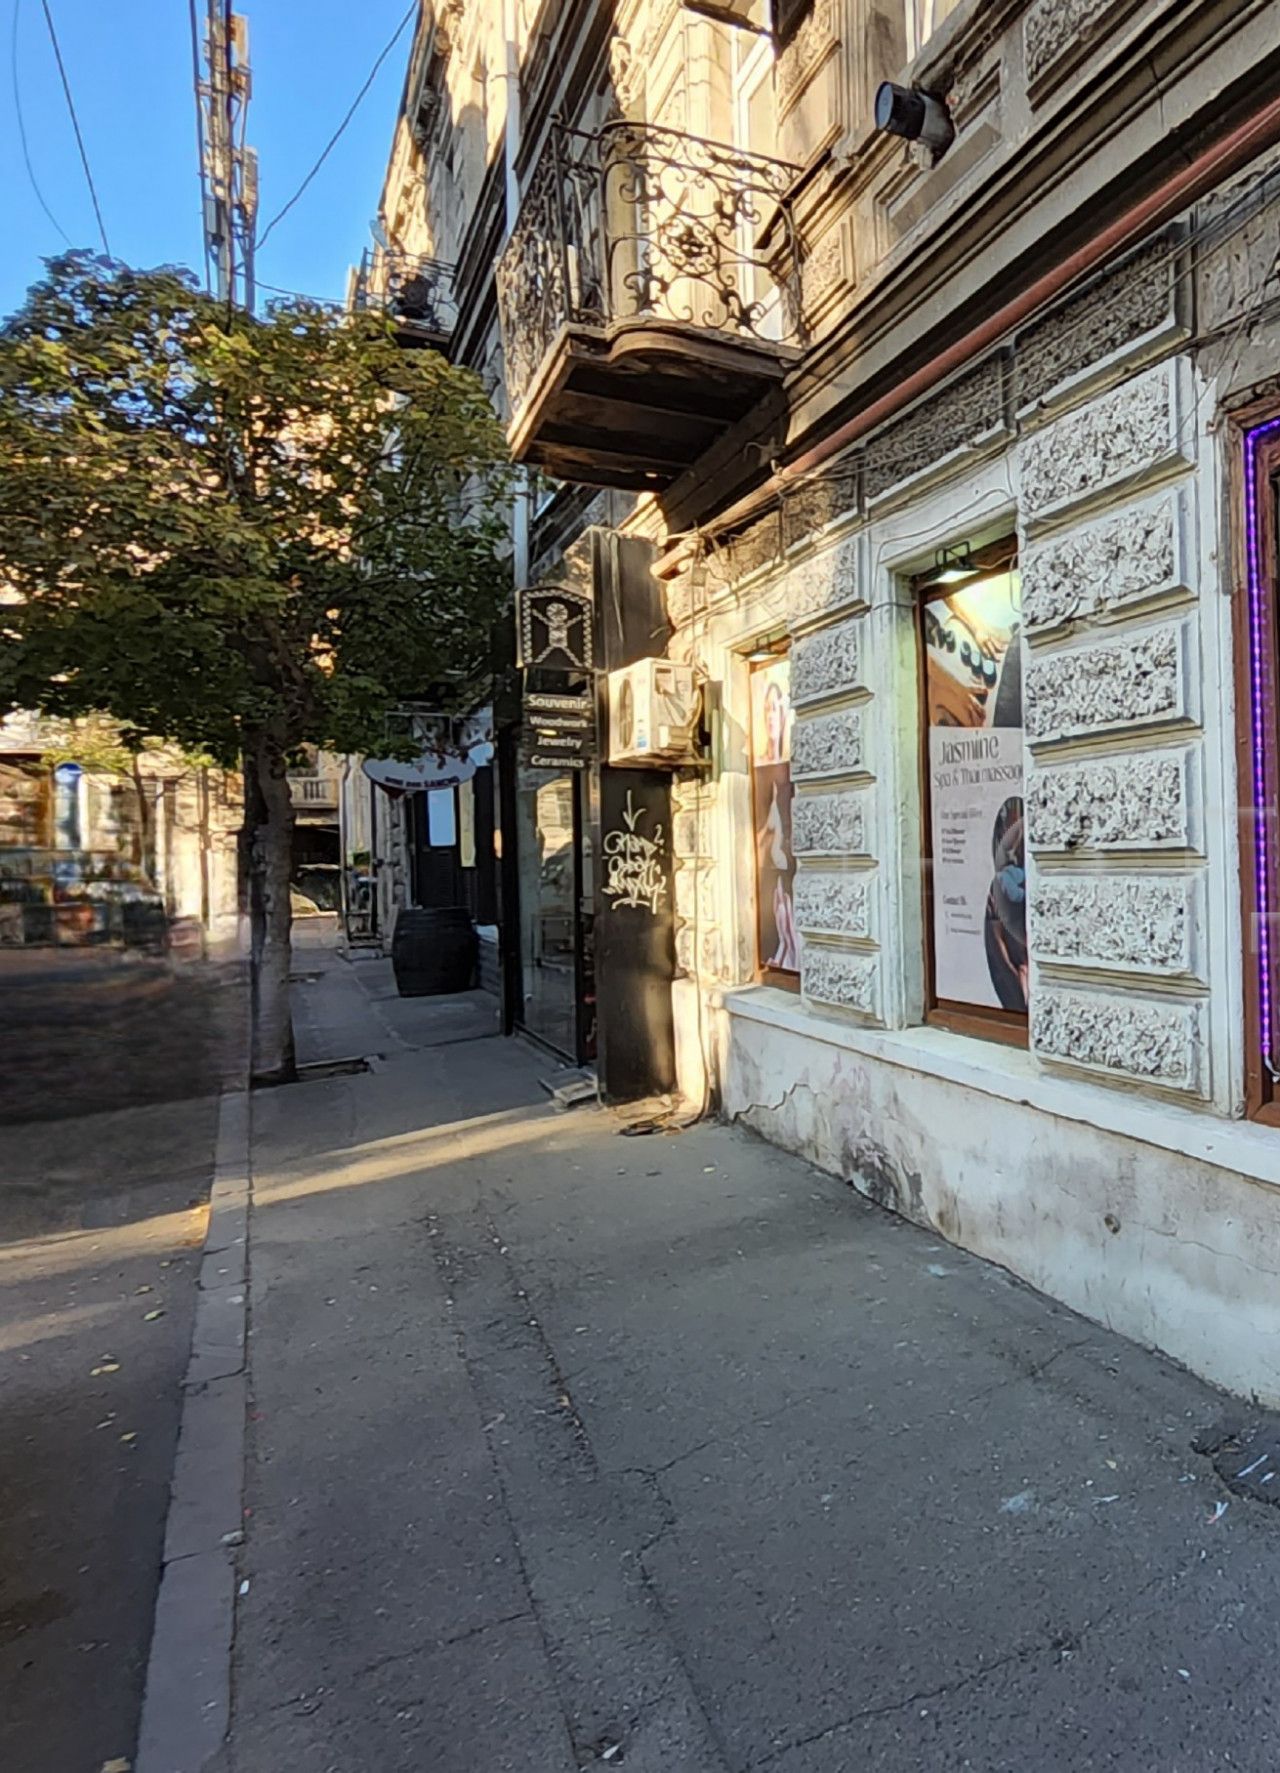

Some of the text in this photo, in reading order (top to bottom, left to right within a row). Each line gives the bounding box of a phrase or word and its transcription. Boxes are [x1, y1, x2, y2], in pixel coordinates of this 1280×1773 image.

[528, 695, 588, 709] Souvenir
[529, 716, 588, 728] Woodwork
[536, 736, 583, 750] Jewelry
[938, 731, 999, 765] Jasmine
[531, 755, 585, 768] Ceramics
[960, 764, 980, 786] Thai
